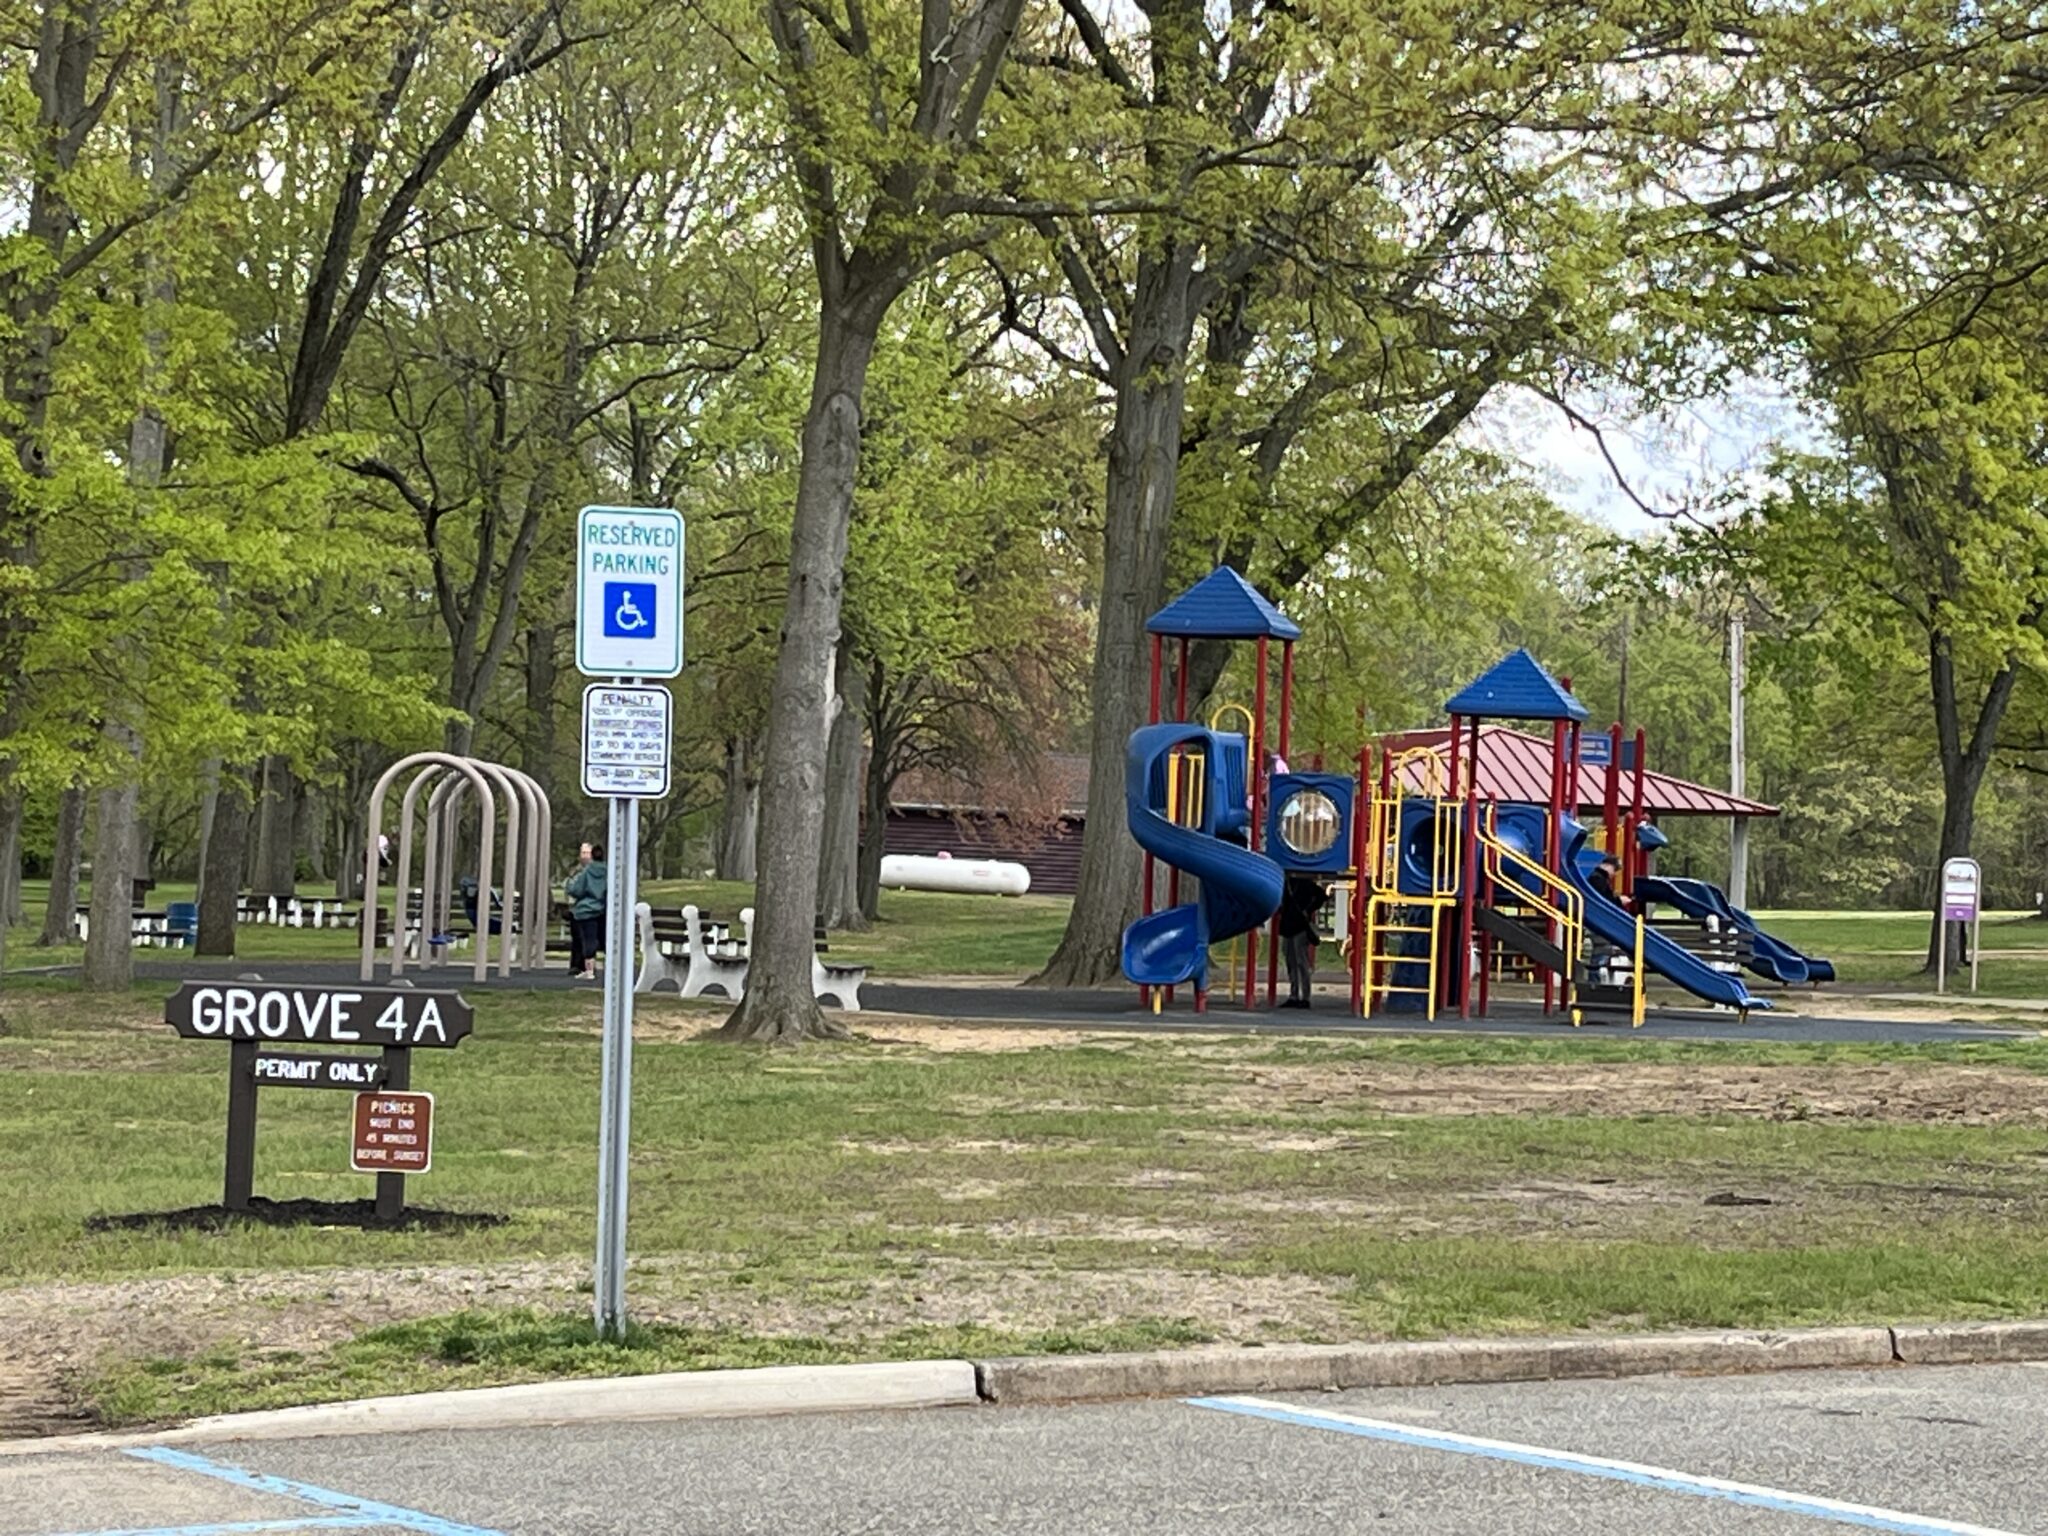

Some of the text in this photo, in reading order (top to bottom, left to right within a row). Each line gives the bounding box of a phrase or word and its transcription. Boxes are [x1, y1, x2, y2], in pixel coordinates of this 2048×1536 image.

[588, 524, 676, 547] RESERVED
[592, 552, 669, 575] PARKING
[601, 693, 654, 706] PENALTY
[607, 740, 619, 749] TO
[191, 988, 447, 1043] GROVE 4A
[255, 1058, 378, 1083] PERMIT ONLY
[371, 1100, 416, 1115] PICNICS
